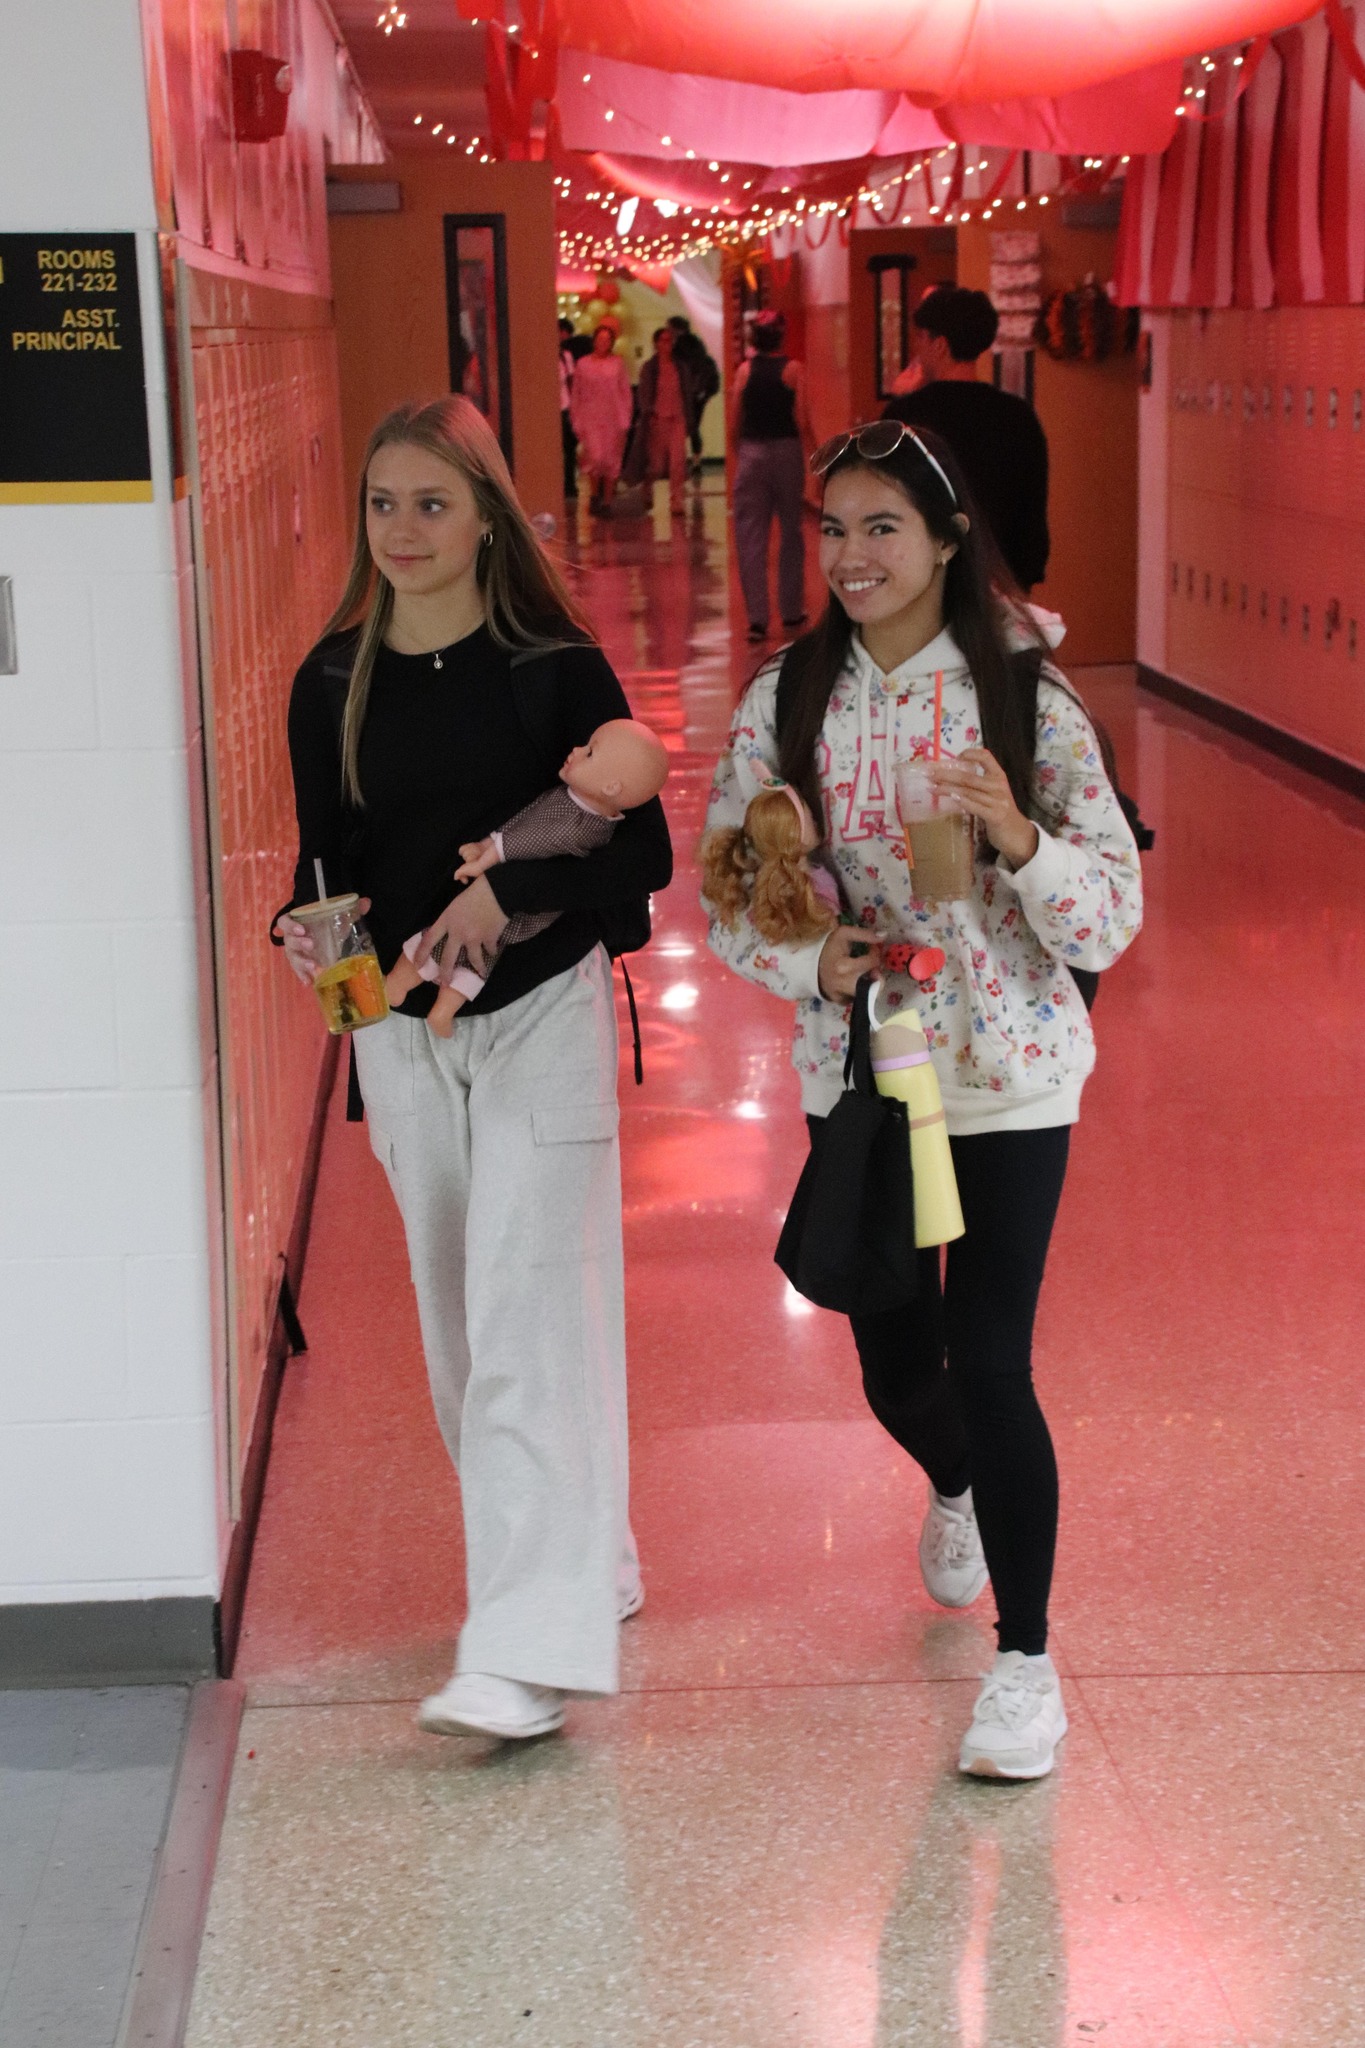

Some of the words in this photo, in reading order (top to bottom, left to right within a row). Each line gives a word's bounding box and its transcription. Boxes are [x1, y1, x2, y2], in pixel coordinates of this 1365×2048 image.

[37, 249, 116, 270] ROOMS
[41, 272, 118, 292] 221-232
[61, 308, 120, 328] ASST.
[12, 331, 122, 351] PRINCIPAL
